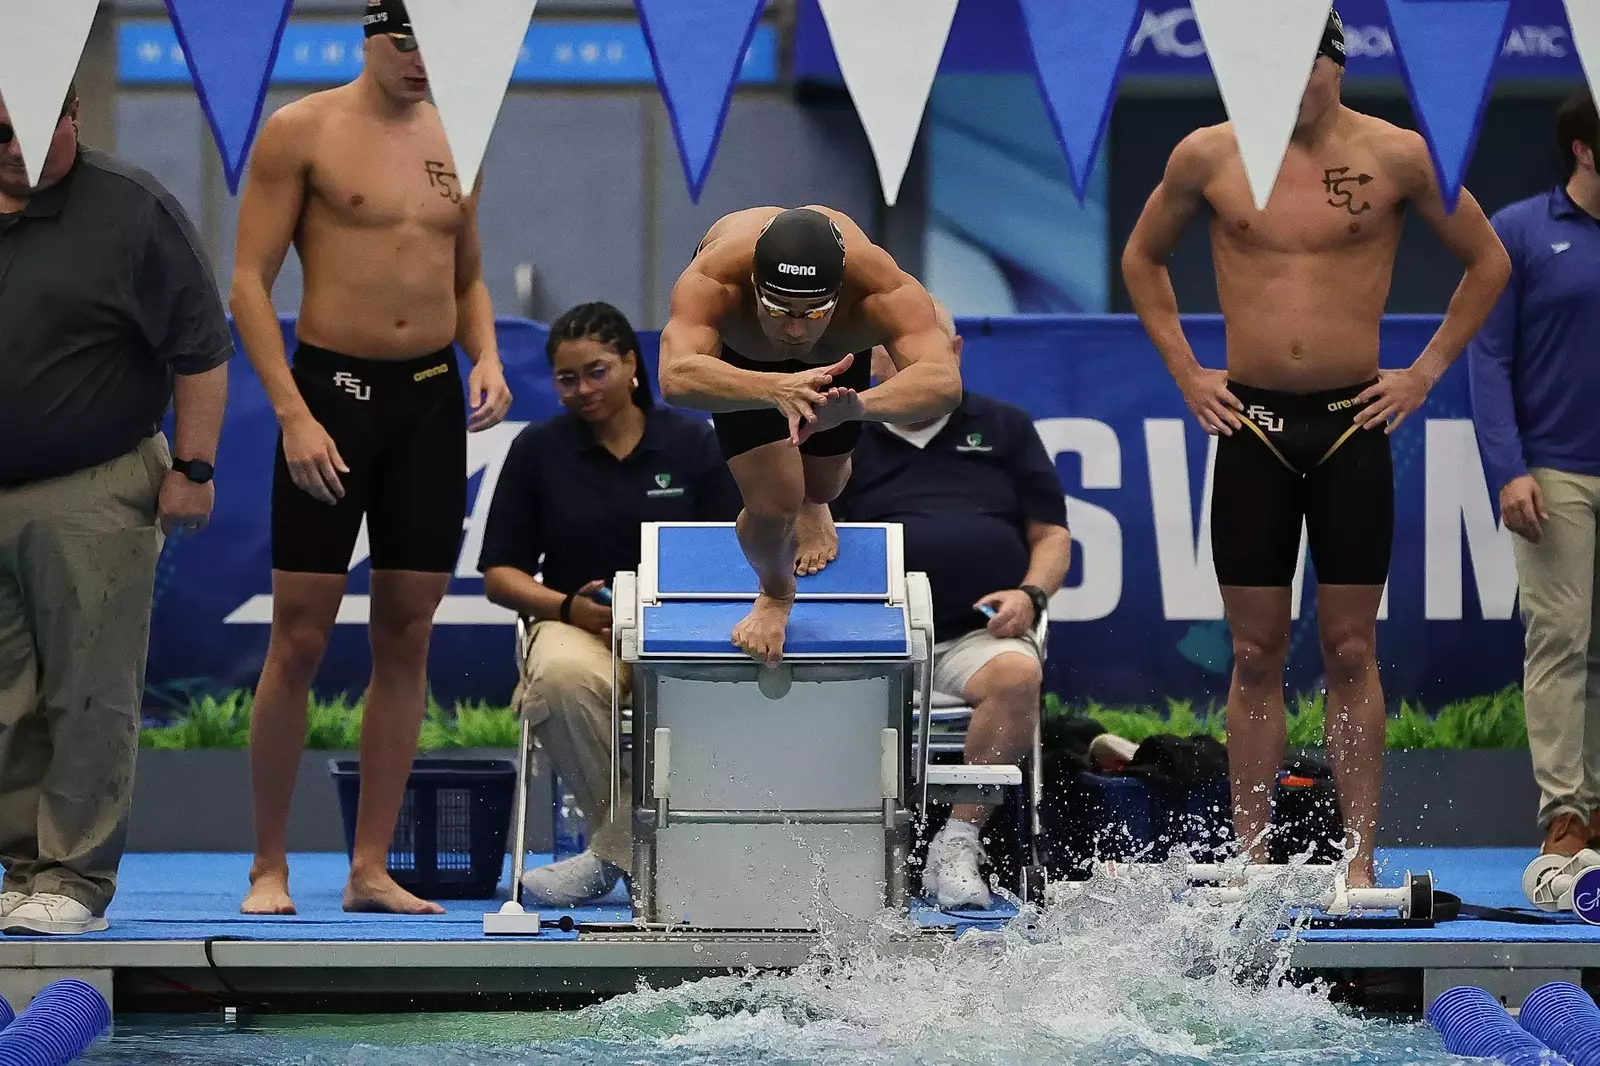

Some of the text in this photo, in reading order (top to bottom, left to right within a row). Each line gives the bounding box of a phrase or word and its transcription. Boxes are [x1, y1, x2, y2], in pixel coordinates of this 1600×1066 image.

[778, 262, 816, 276] arena
[413, 363, 449, 382] arena
[333, 371, 371, 400] FSU
[1247, 405, 1284, 432] FSU
